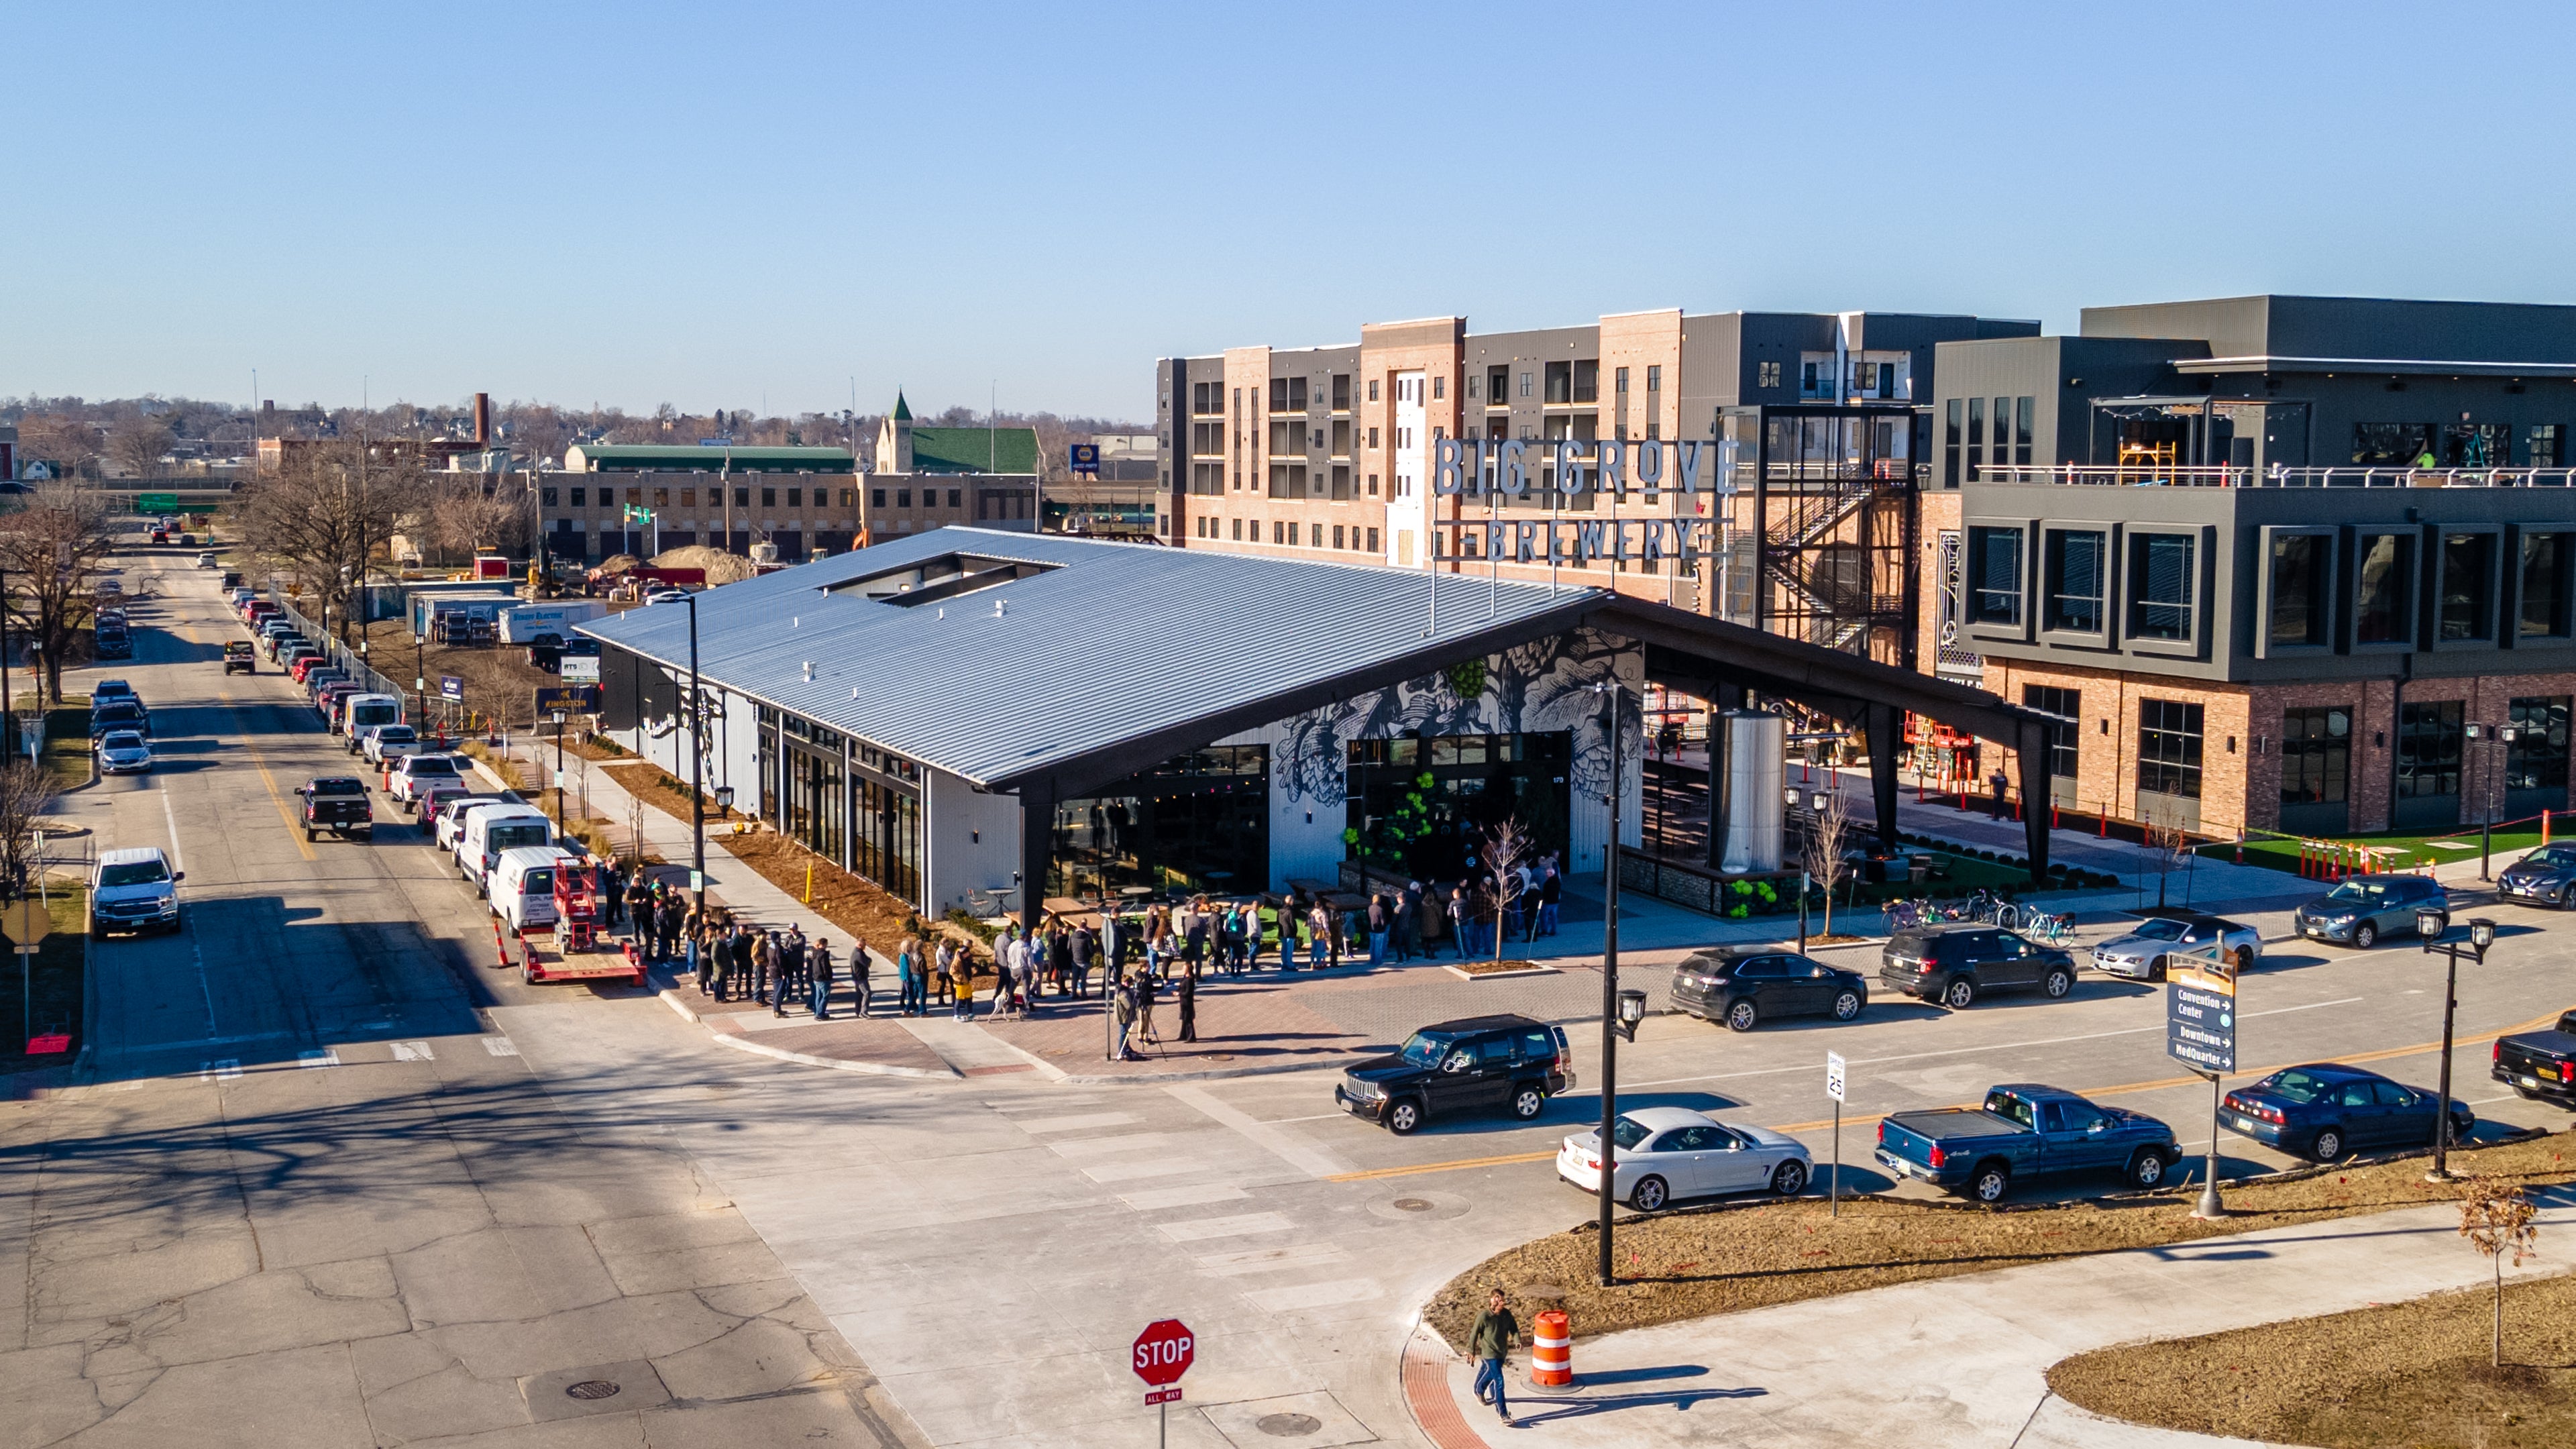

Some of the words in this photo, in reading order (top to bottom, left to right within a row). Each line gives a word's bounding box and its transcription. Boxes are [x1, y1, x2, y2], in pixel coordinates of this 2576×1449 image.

[1436, 439, 1525, 495] BIG
[1559, 439, 1739, 495] GROVE
[2178, 989, 2220, 1010] Convention
[2178, 1003, 2202, 1020] Center
[2180, 1026, 2220, 1046] Downtown
[2176, 1044, 2220, 1065] MedQuarter
[1829, 1075, 1842, 1095] 25
[1136, 1336, 1191, 1368] STOP
[1147, 1394, 1161, 1403] ALL
[1166, 1391, 1180, 1400] WAY
